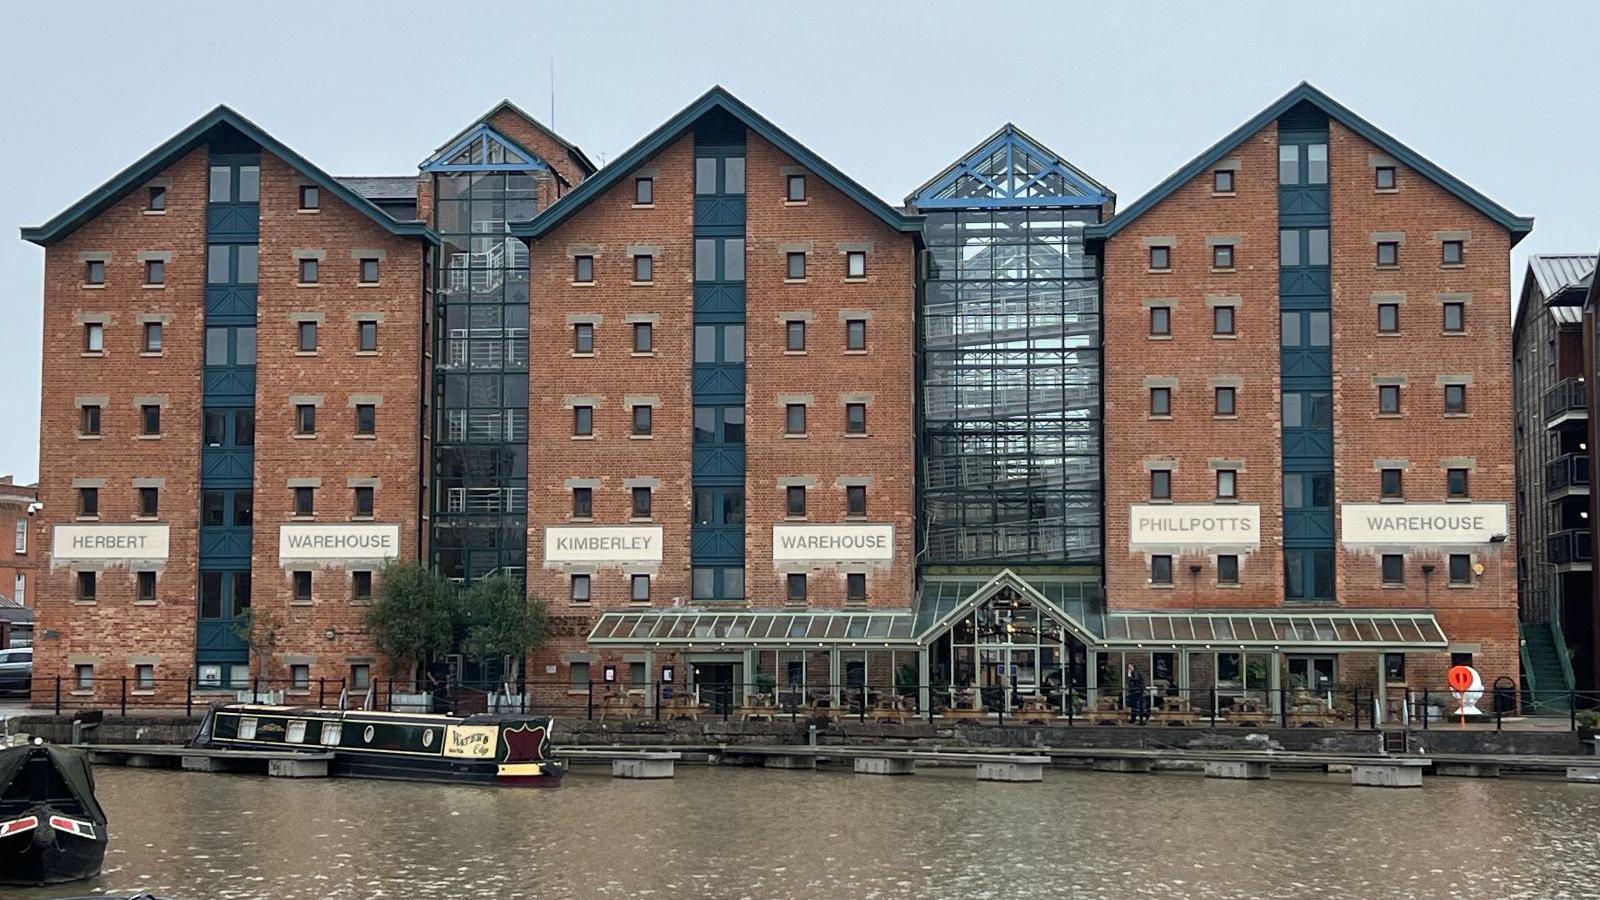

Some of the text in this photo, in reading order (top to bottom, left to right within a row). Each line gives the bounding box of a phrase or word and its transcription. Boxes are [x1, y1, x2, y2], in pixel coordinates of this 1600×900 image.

[1139, 518, 1251, 531] PHILLPOTTS
[1367, 516, 1484, 531] WAREHOUSE
[72, 535, 147, 549] HERBERT
[287, 535, 391, 548] WAREHOUSE
[556, 536, 652, 550] KIMBERLEY
[781, 535, 886, 549] WAREHOUSE
